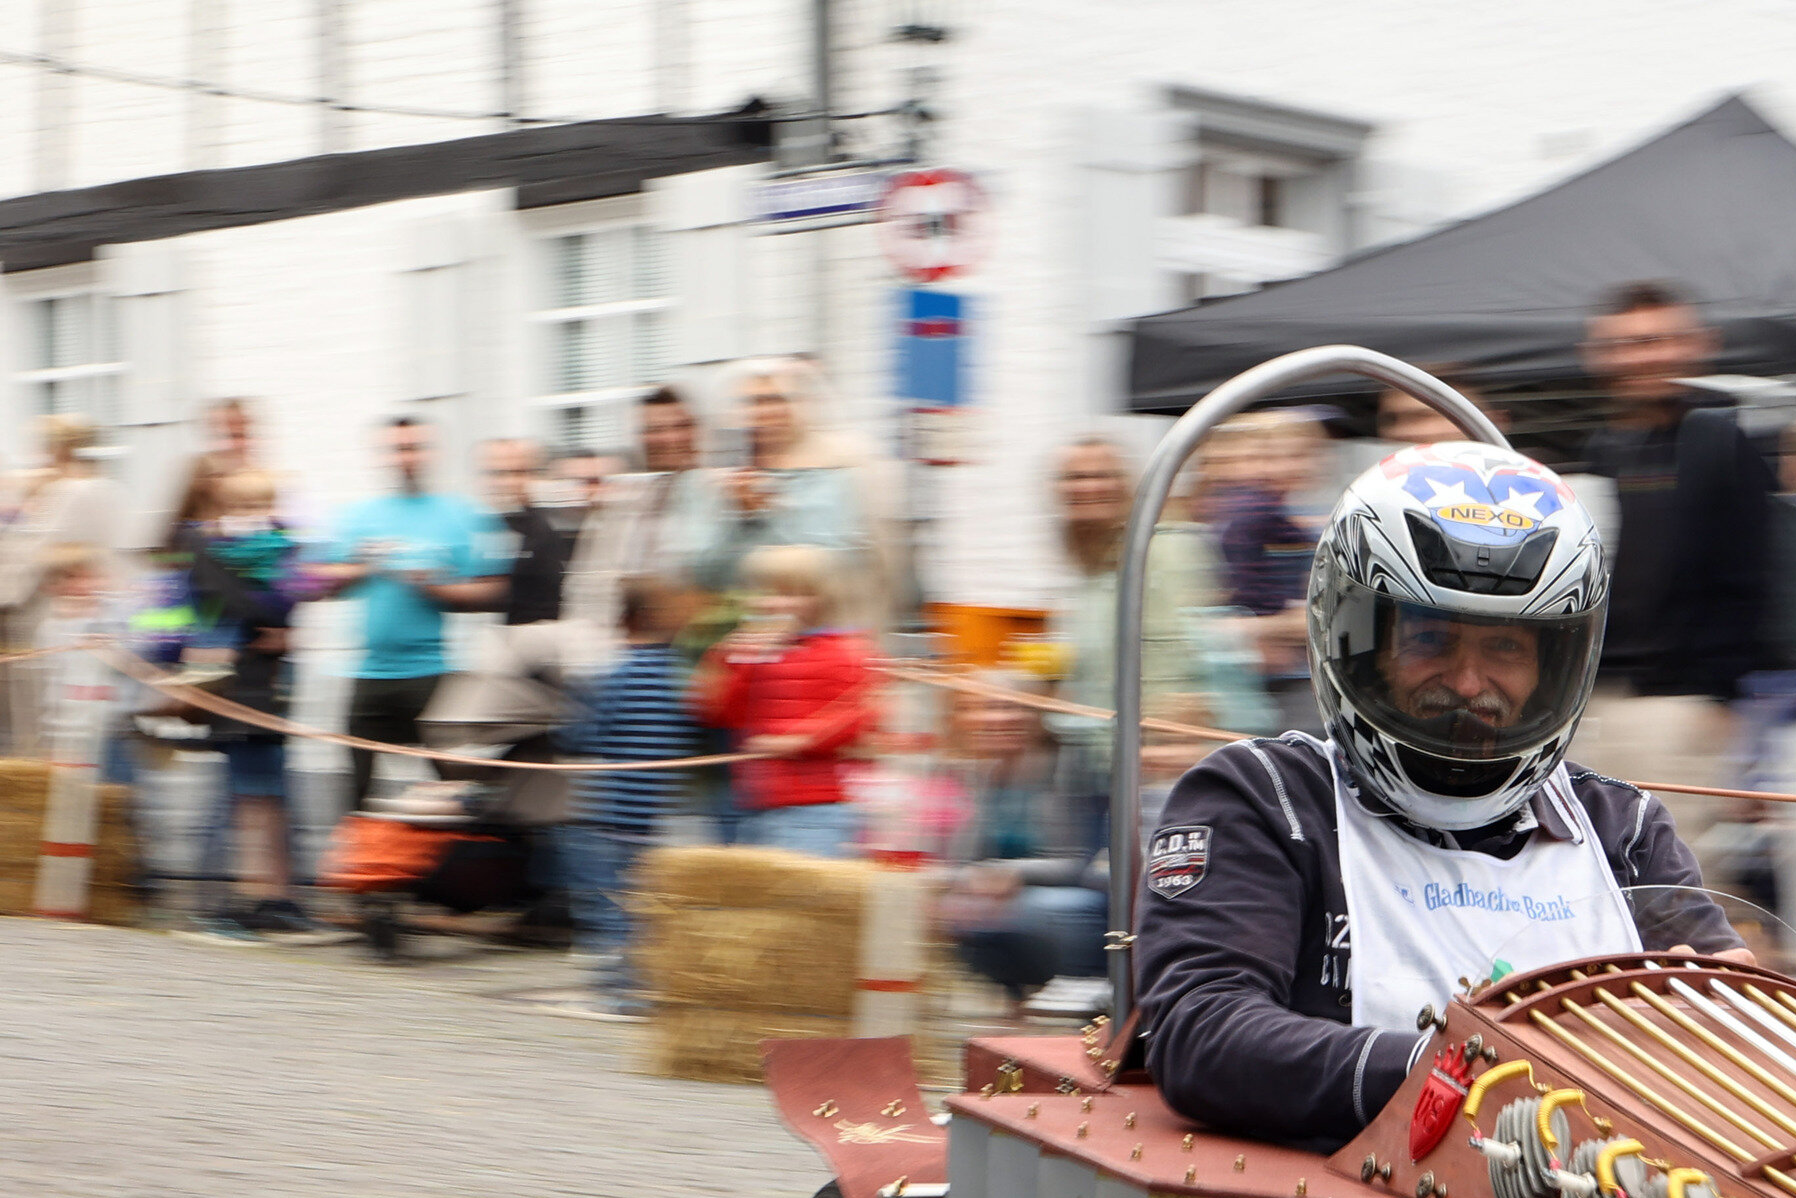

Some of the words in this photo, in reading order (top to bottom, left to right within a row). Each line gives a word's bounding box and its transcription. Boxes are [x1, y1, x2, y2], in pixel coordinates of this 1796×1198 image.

[1451, 507, 1524, 528] NEXO
[1157, 874, 1194, 888] 1963
[1424, 882, 1521, 912] Gladbache
[1521, 894, 1576, 922] Bank
